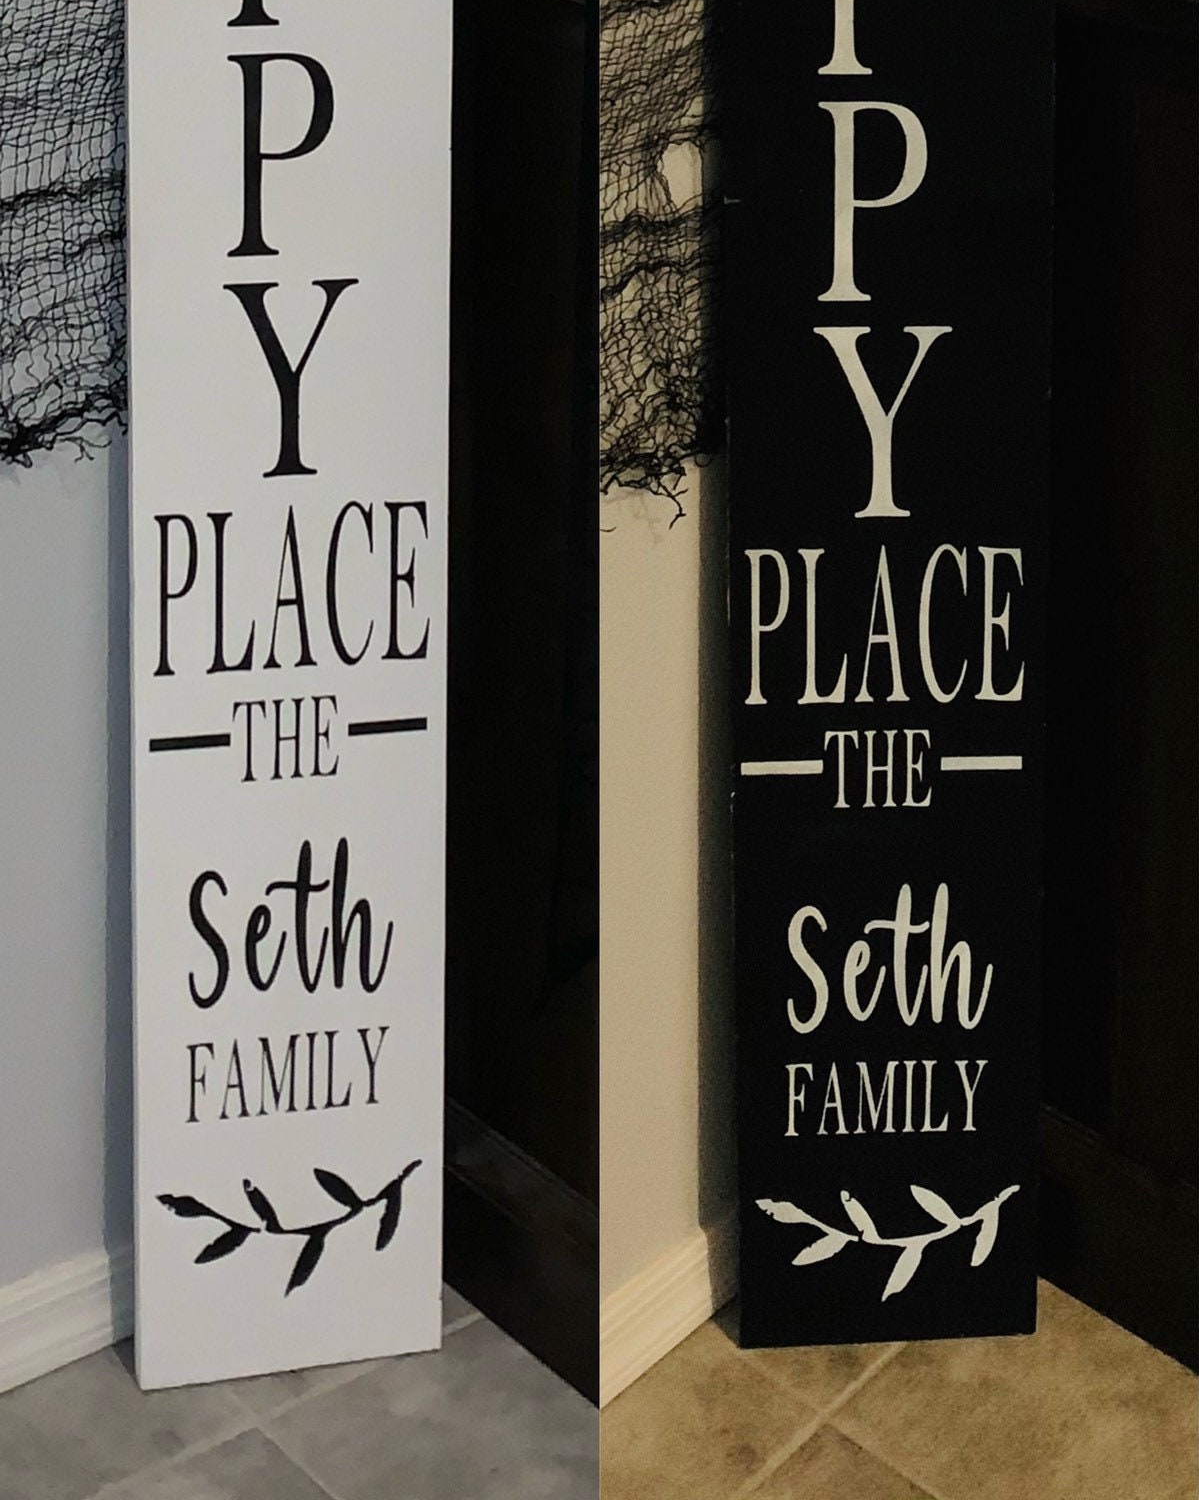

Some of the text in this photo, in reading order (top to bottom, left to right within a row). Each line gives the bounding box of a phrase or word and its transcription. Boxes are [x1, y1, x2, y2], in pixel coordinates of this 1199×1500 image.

[154, 501, 429, 676] PLACE
[745, 544, 1024, 704] PLACE
[233, 695, 338, 782] THE
[824, 729, 931, 808] THE
[189, 838, 393, 1009] Seth
[788, 883, 993, 1033] Seth
[187, 1026, 389, 1122] FAMILY
[785, 1060, 988, 1136] FAMILY
